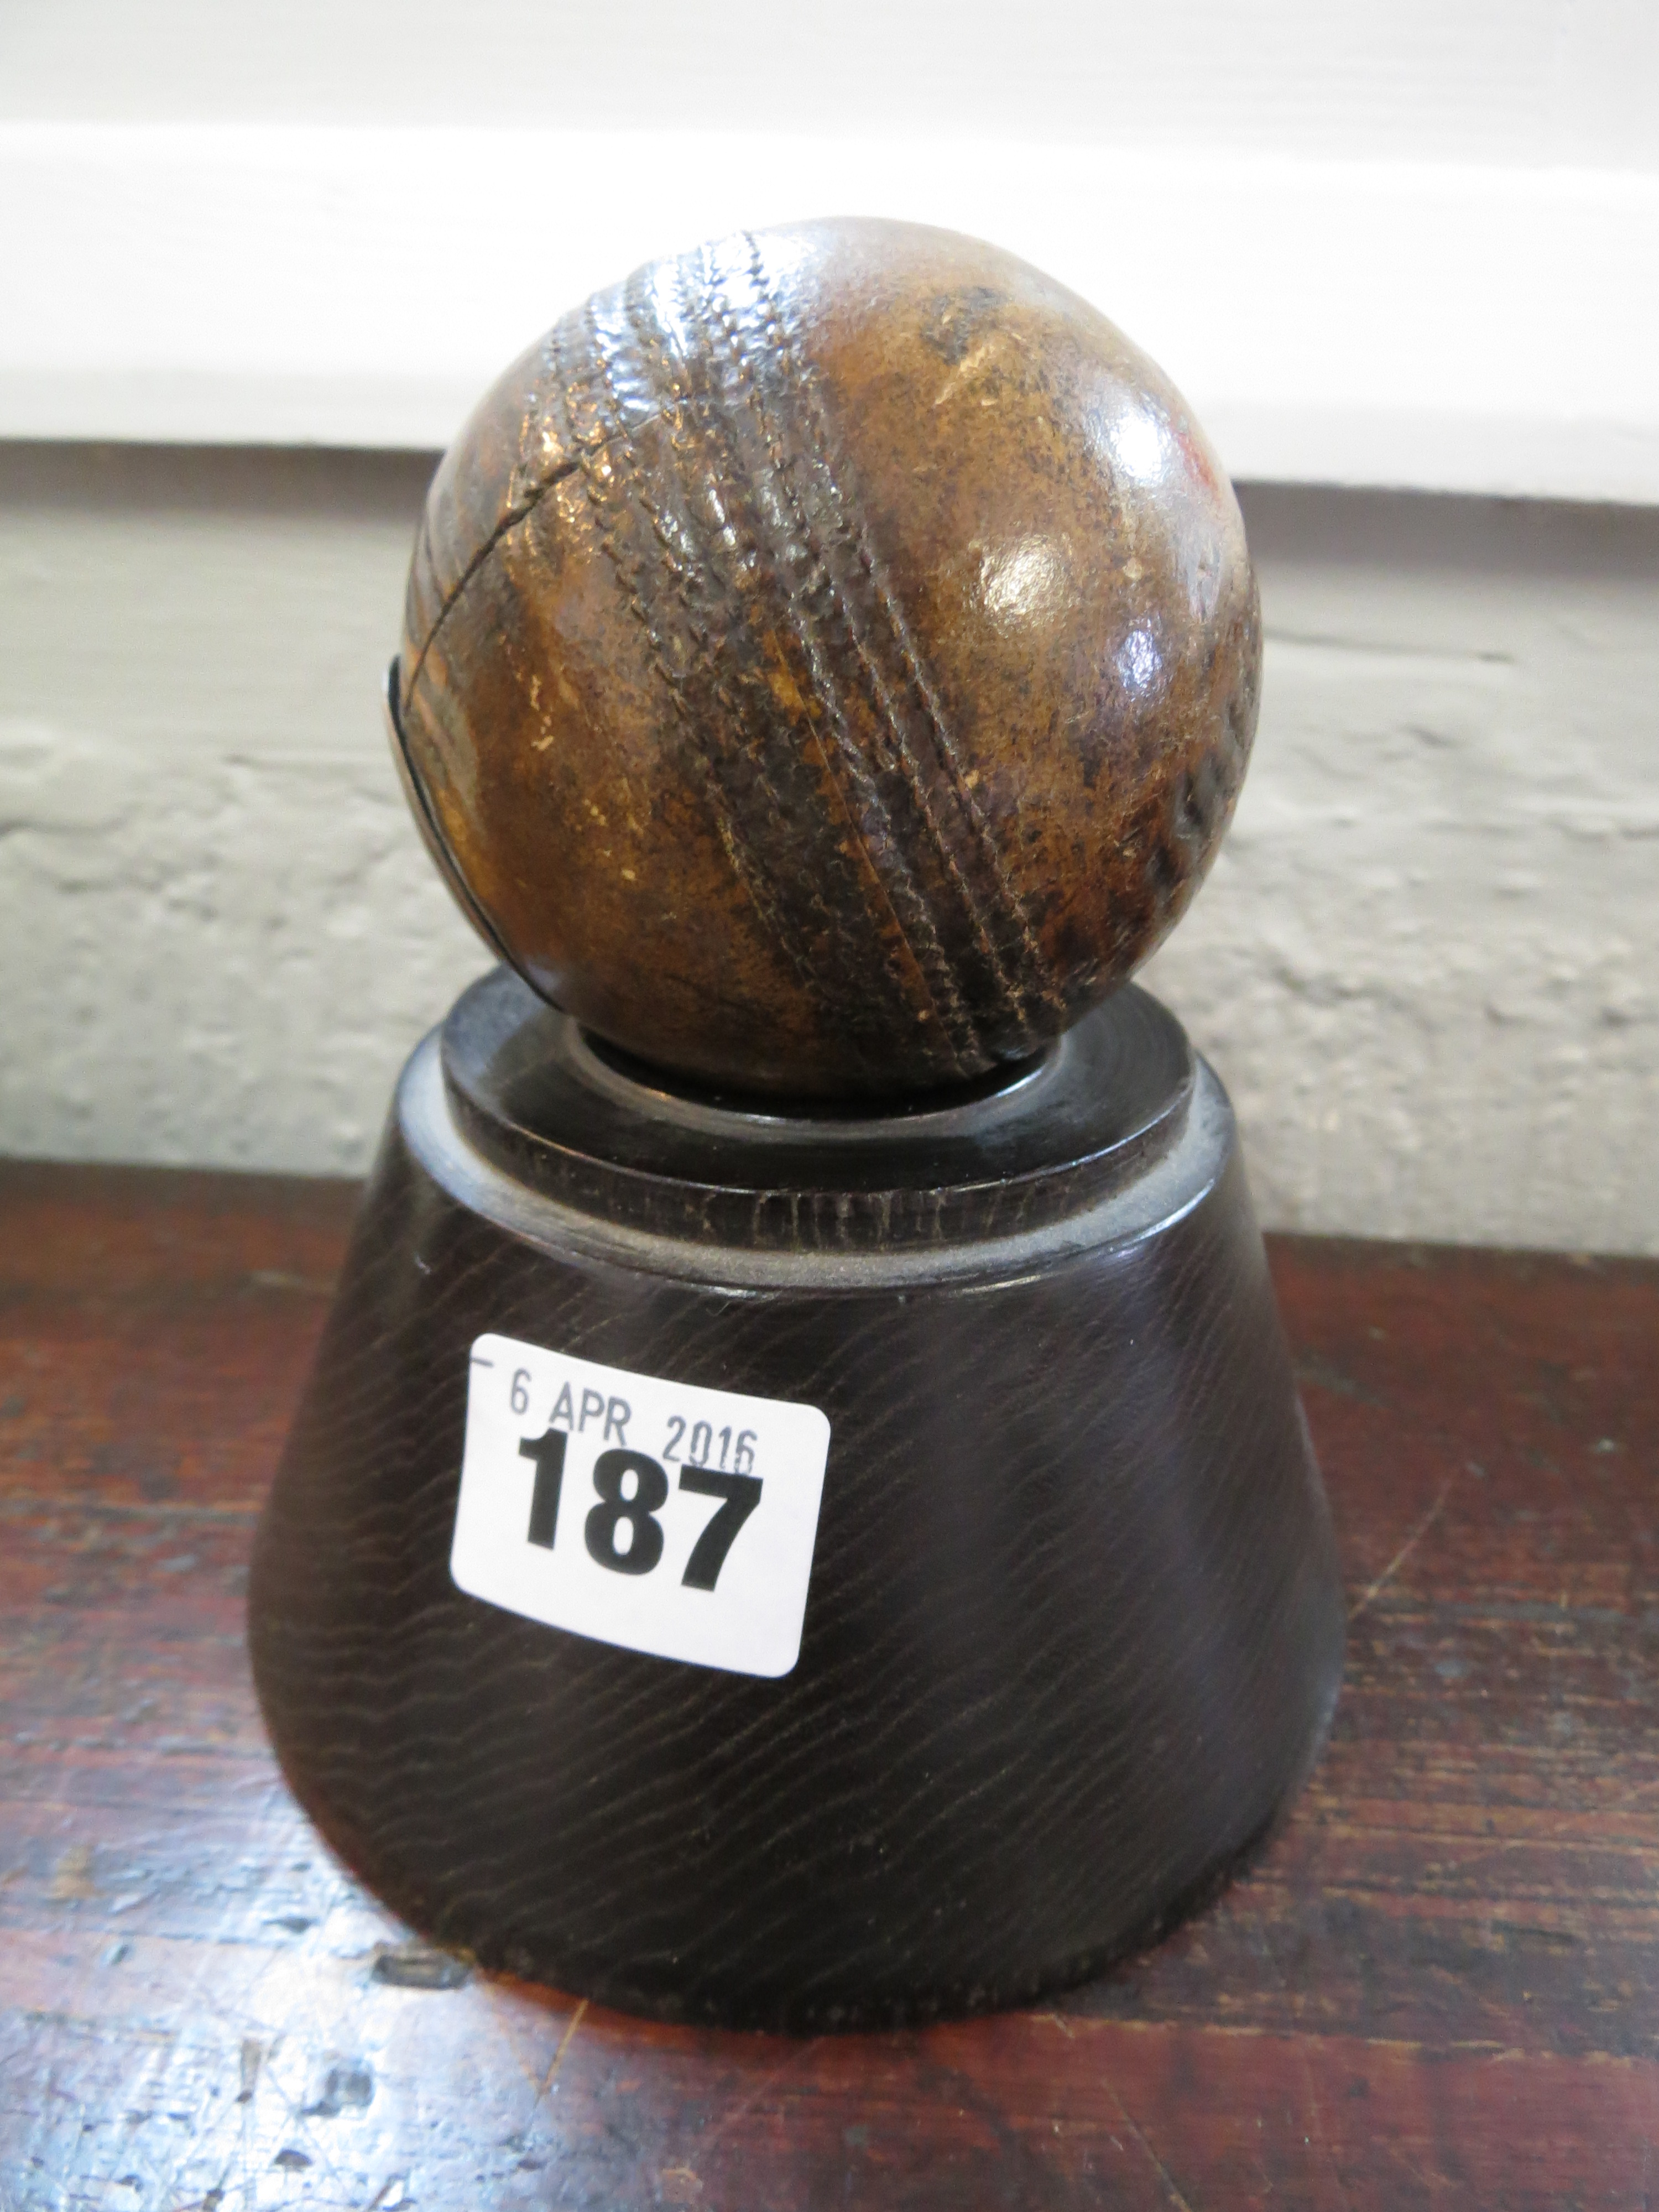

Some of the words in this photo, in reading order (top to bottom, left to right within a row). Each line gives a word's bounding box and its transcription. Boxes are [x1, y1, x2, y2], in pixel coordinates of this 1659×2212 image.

[510, 1368, 532, 1415] 6
[549, 1381, 632, 1447] APR
[662, 1415, 758, 1475] 2016
[518, 1427, 764, 1592] 187
